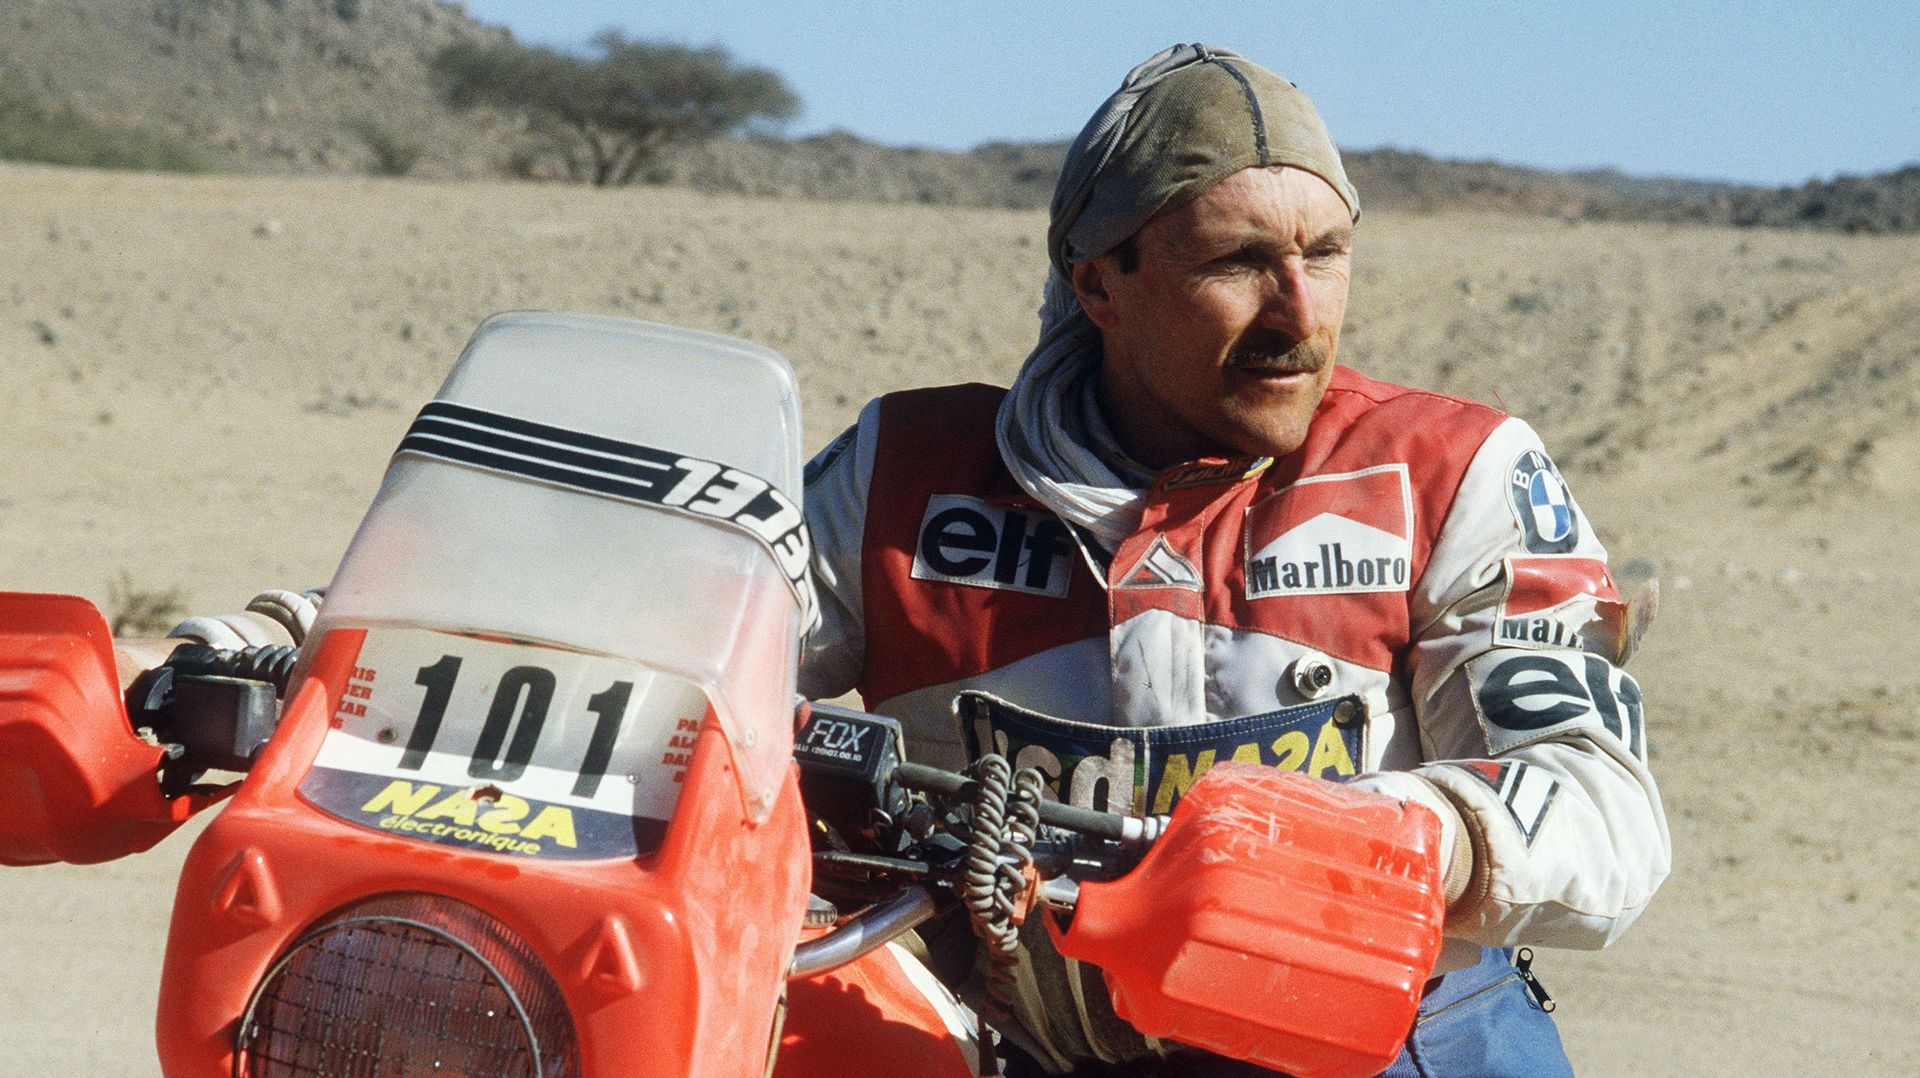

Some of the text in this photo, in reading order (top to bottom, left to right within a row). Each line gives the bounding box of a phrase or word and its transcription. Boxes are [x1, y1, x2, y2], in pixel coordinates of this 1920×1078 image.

[921, 507, 1072, 589] elf
[1251, 542, 1406, 593] Marlboro
[398, 654, 634, 799] 101
[806, 719, 870, 752] FOX
[1479, 655, 1642, 763] elf
